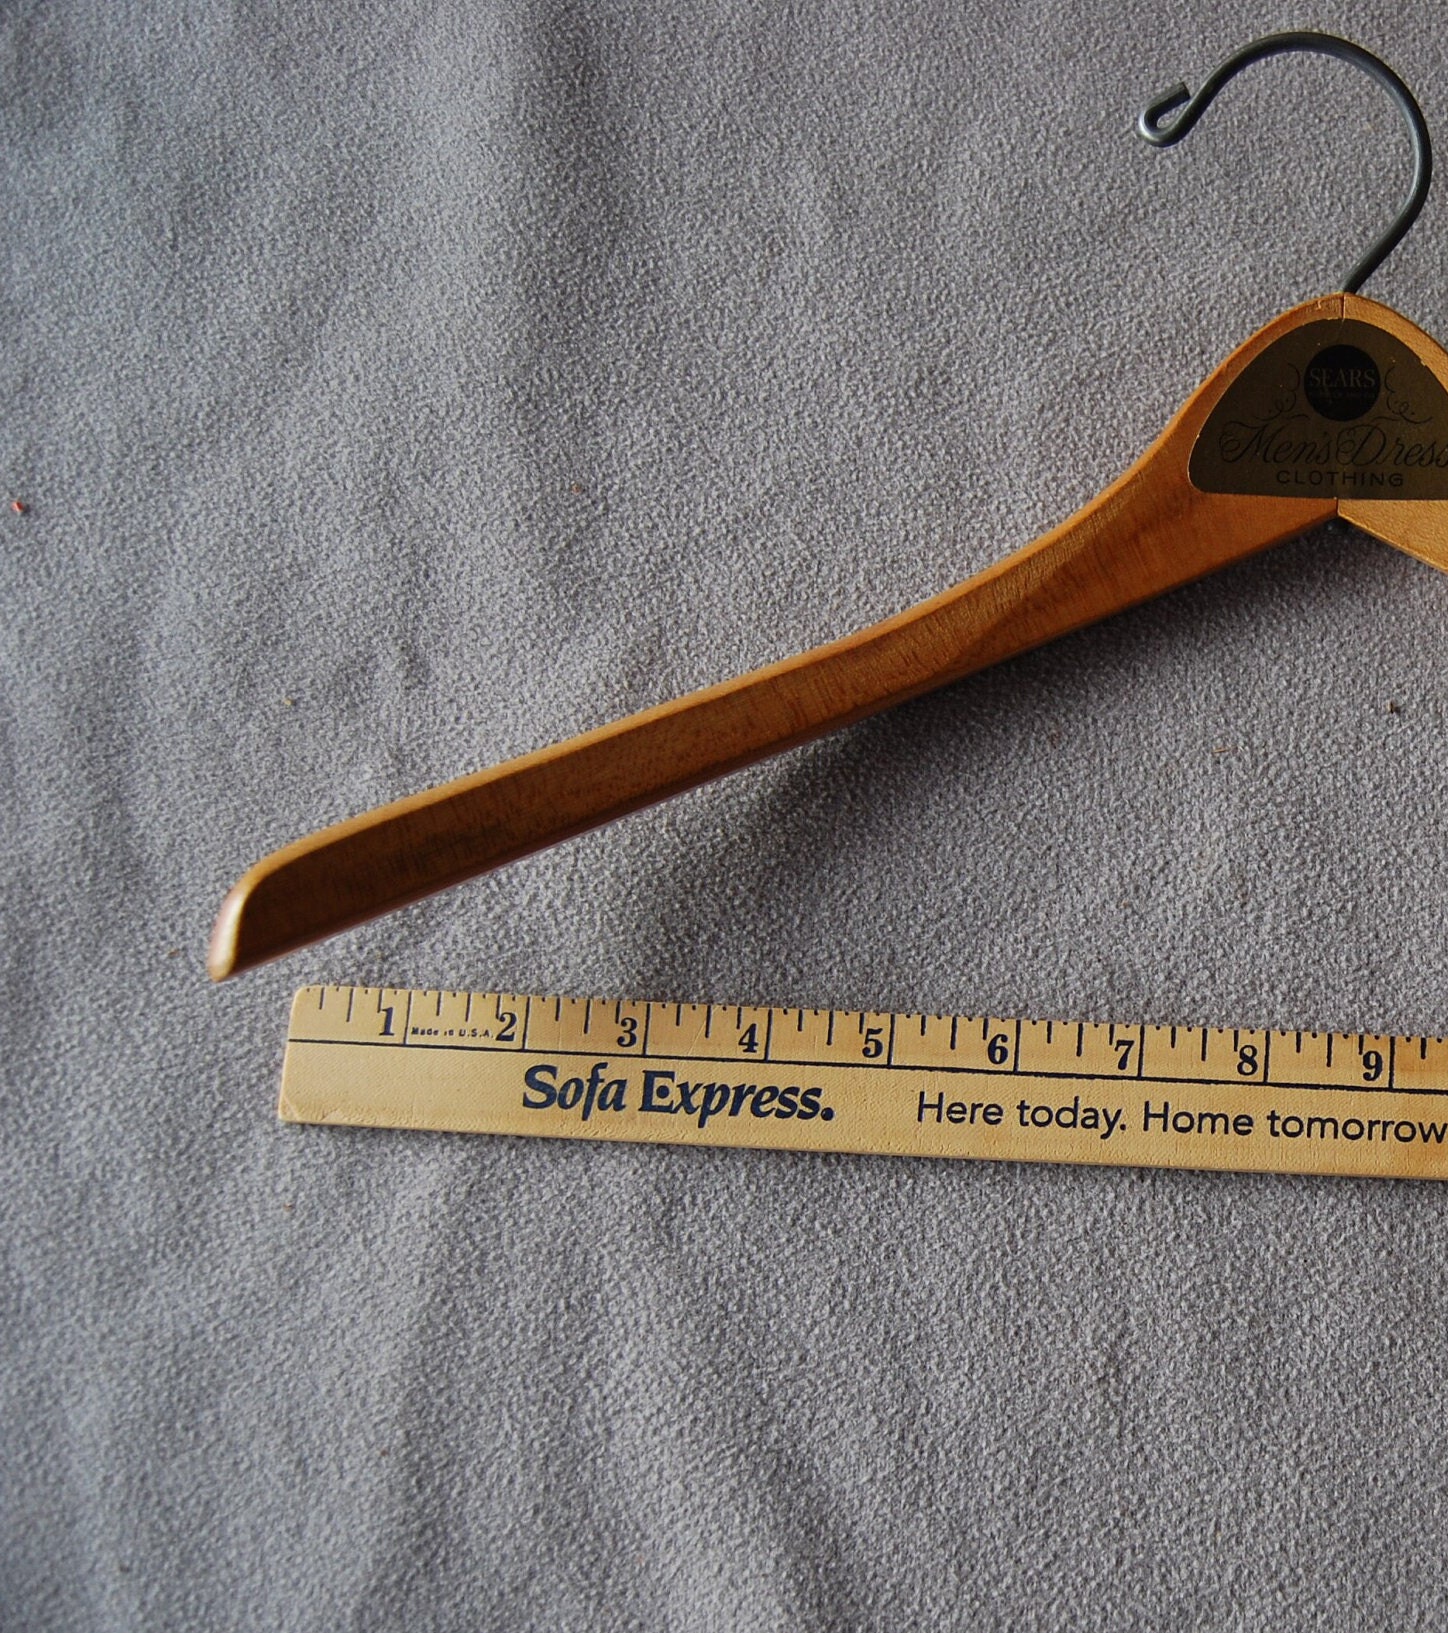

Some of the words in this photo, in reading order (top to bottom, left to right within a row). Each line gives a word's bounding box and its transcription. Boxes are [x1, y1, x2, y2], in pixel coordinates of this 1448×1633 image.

[1308, 367, 1376, 389] SEARS
[1218, 420, 1333, 464] Men's
[1275, 469, 1405, 488] CLOTHING
[378, 1006, 395, 1036] 1
[495, 1012, 518, 1041] 2
[616, 1017, 638, 1047] 3
[738, 1023, 759, 1053] 4
[862, 1028, 883, 1058] 5
[987, 1034, 1008, 1064] 6
[1114, 1040, 1135, 1070] 7
[1236, 1045, 1258, 1076] 8
[1362, 1051, 1383, 1081] 9
[411, 1027, 439, 1036] Made
[458, 1029, 494, 1039] U.S.A.
[522, 1062, 628, 1121] Sofa
[638, 1069, 836, 1129] Express.
[917, 1091, 1004, 1126] Here
[1016, 1095, 1128, 1140] today.
[1143, 1101, 1255, 1136] Home
